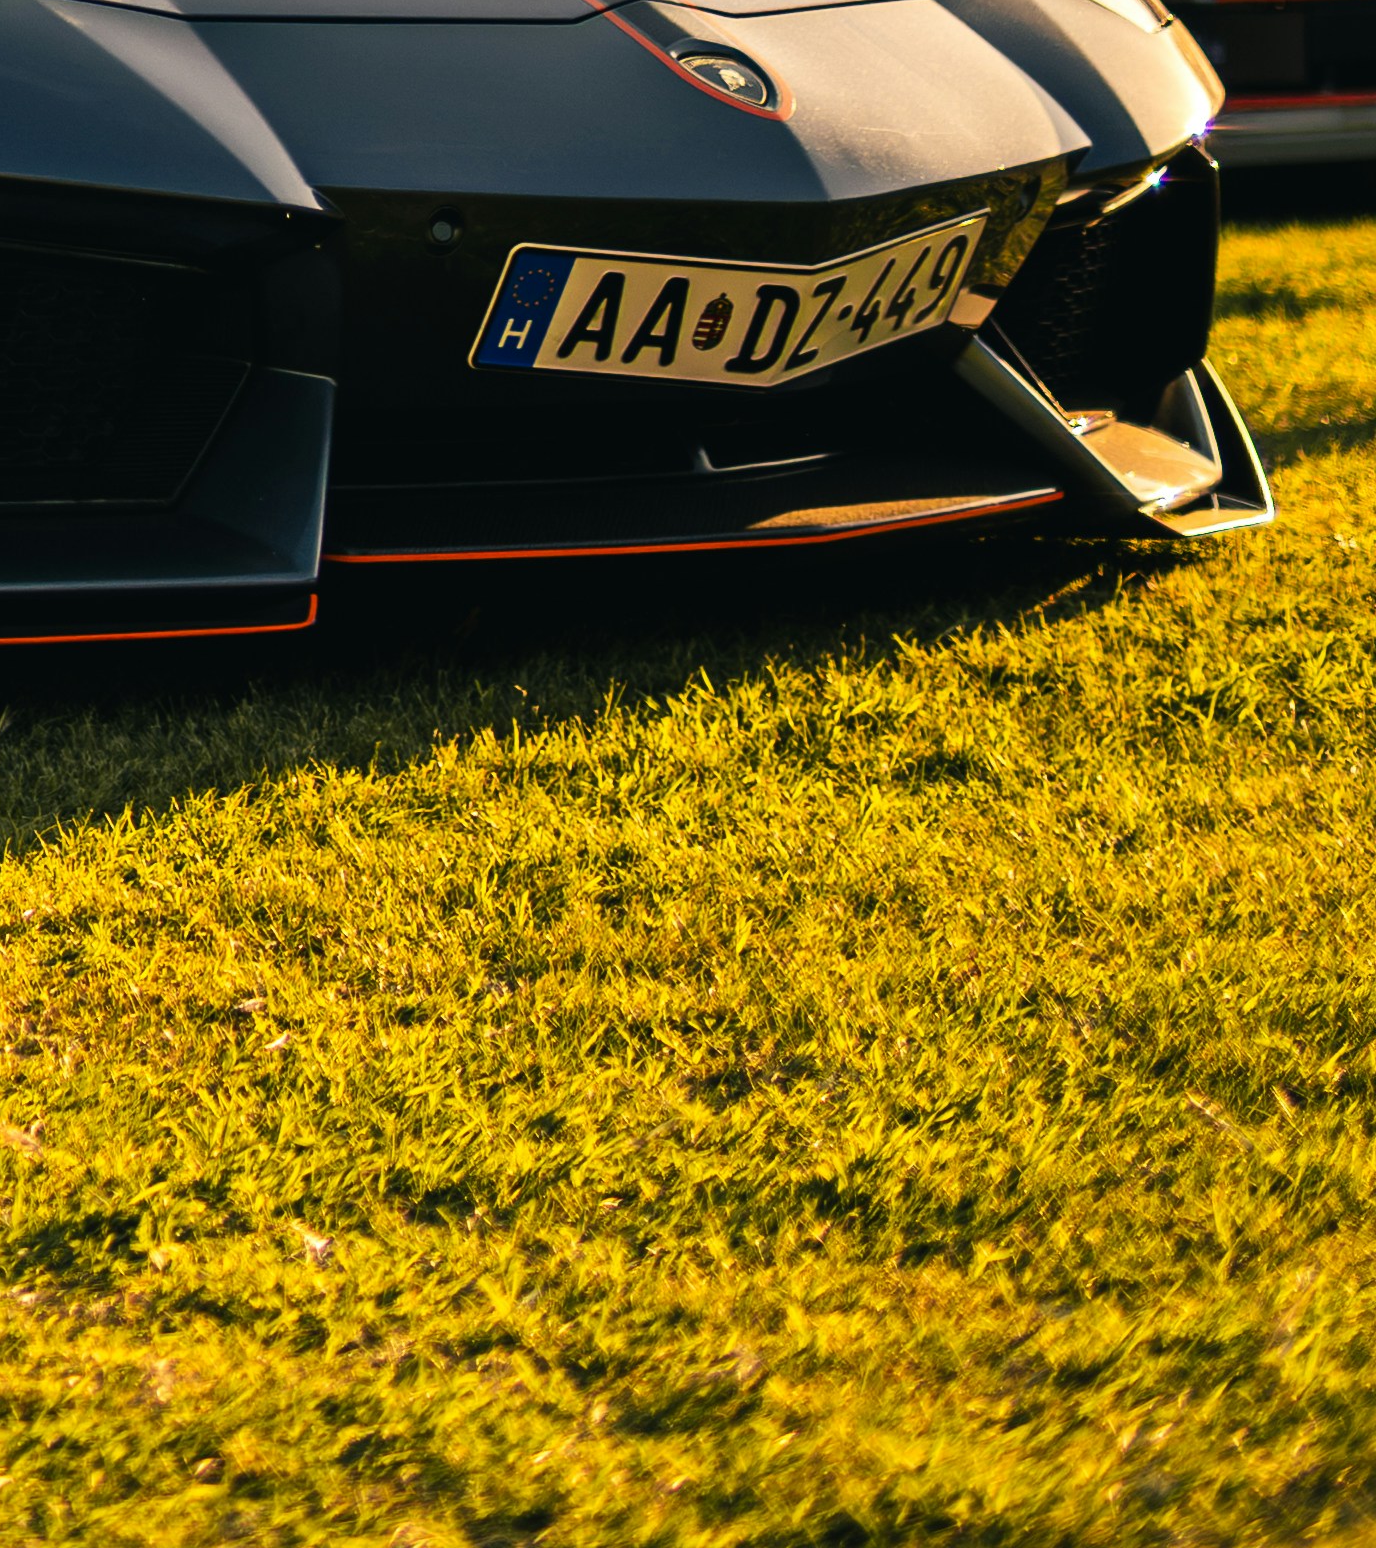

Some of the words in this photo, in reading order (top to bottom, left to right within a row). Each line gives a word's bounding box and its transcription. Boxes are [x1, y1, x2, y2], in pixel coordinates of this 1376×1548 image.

[497, 317, 533, 350] H
[556, 270, 690, 367] AA
[724, 233, 970, 374] DZ-449
